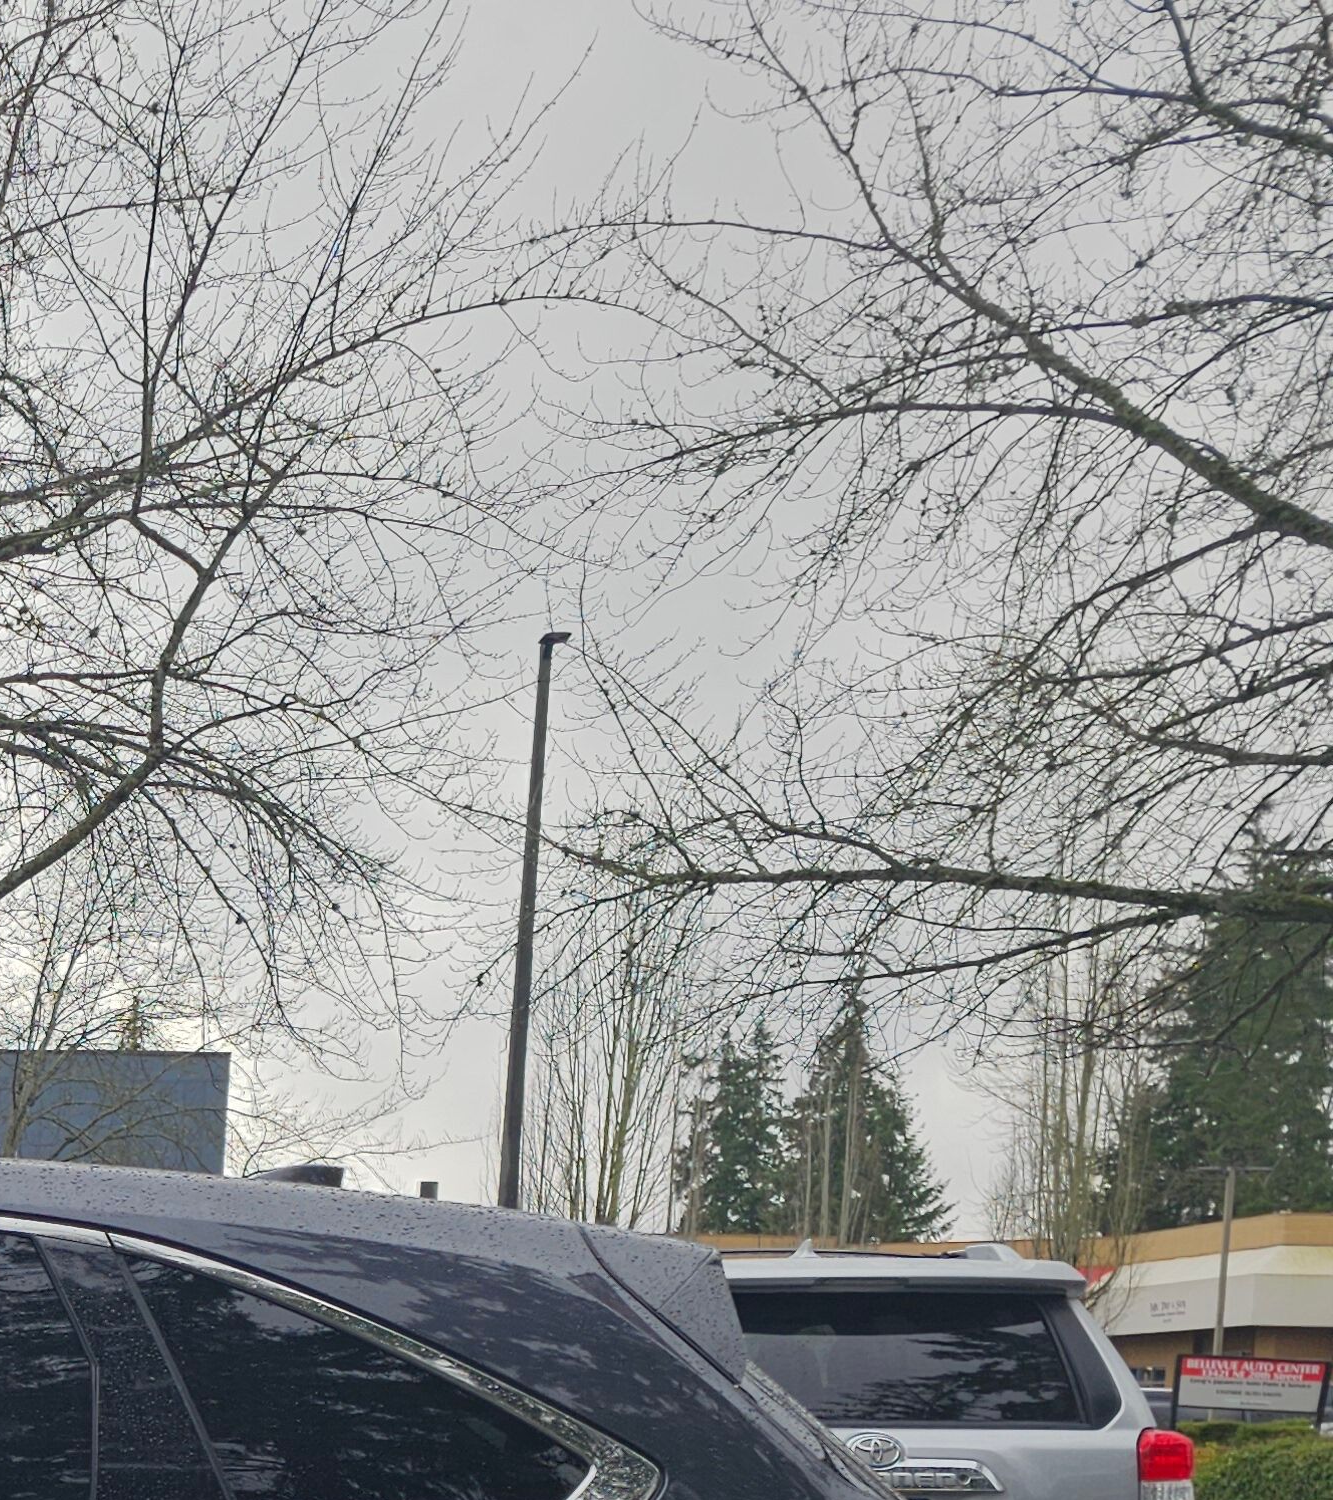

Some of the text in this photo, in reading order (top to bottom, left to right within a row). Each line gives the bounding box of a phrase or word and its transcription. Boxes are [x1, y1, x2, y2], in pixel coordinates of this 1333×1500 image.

[1187, 1358, 1320, 1375] BELLEVUE AUTO CENTER
